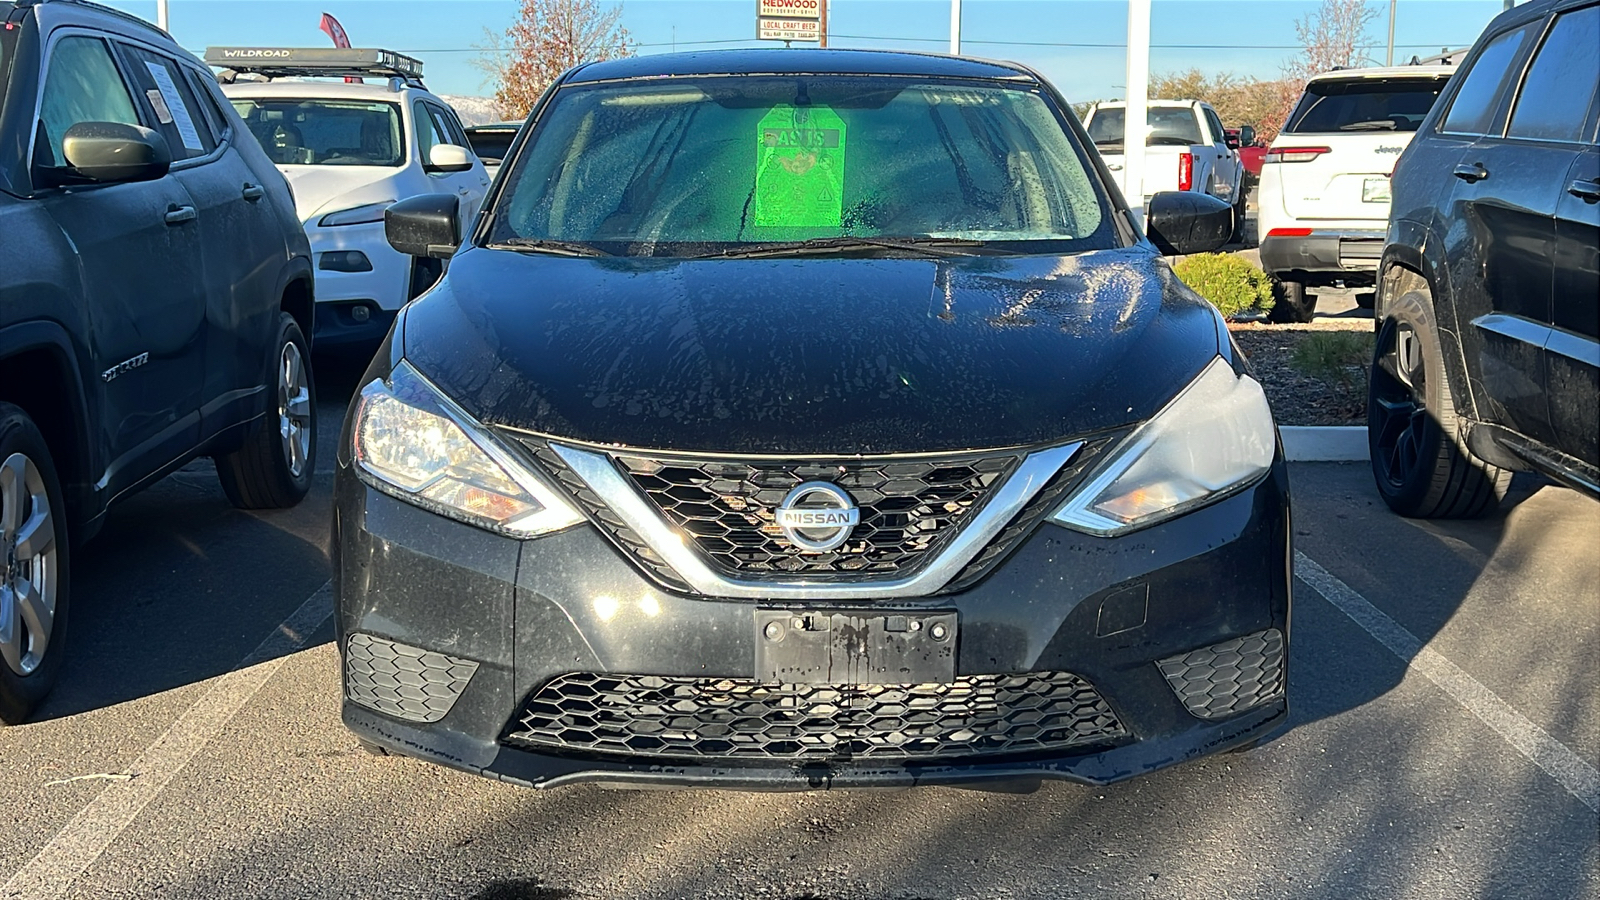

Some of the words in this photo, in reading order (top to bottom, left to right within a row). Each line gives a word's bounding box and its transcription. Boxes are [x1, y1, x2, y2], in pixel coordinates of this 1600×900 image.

[763, 0, 818, 9] REDWOOD
[763, 21, 781, 29] LOCAL
[782, 22, 800, 30] CRAFT
[223, 49, 290, 58] WILDROAD
[777, 130, 799, 146] AS
[807, 130, 825, 147] IS
[1374, 145, 1403, 155] Jeep
[785, 512, 850, 524] NISSAN
